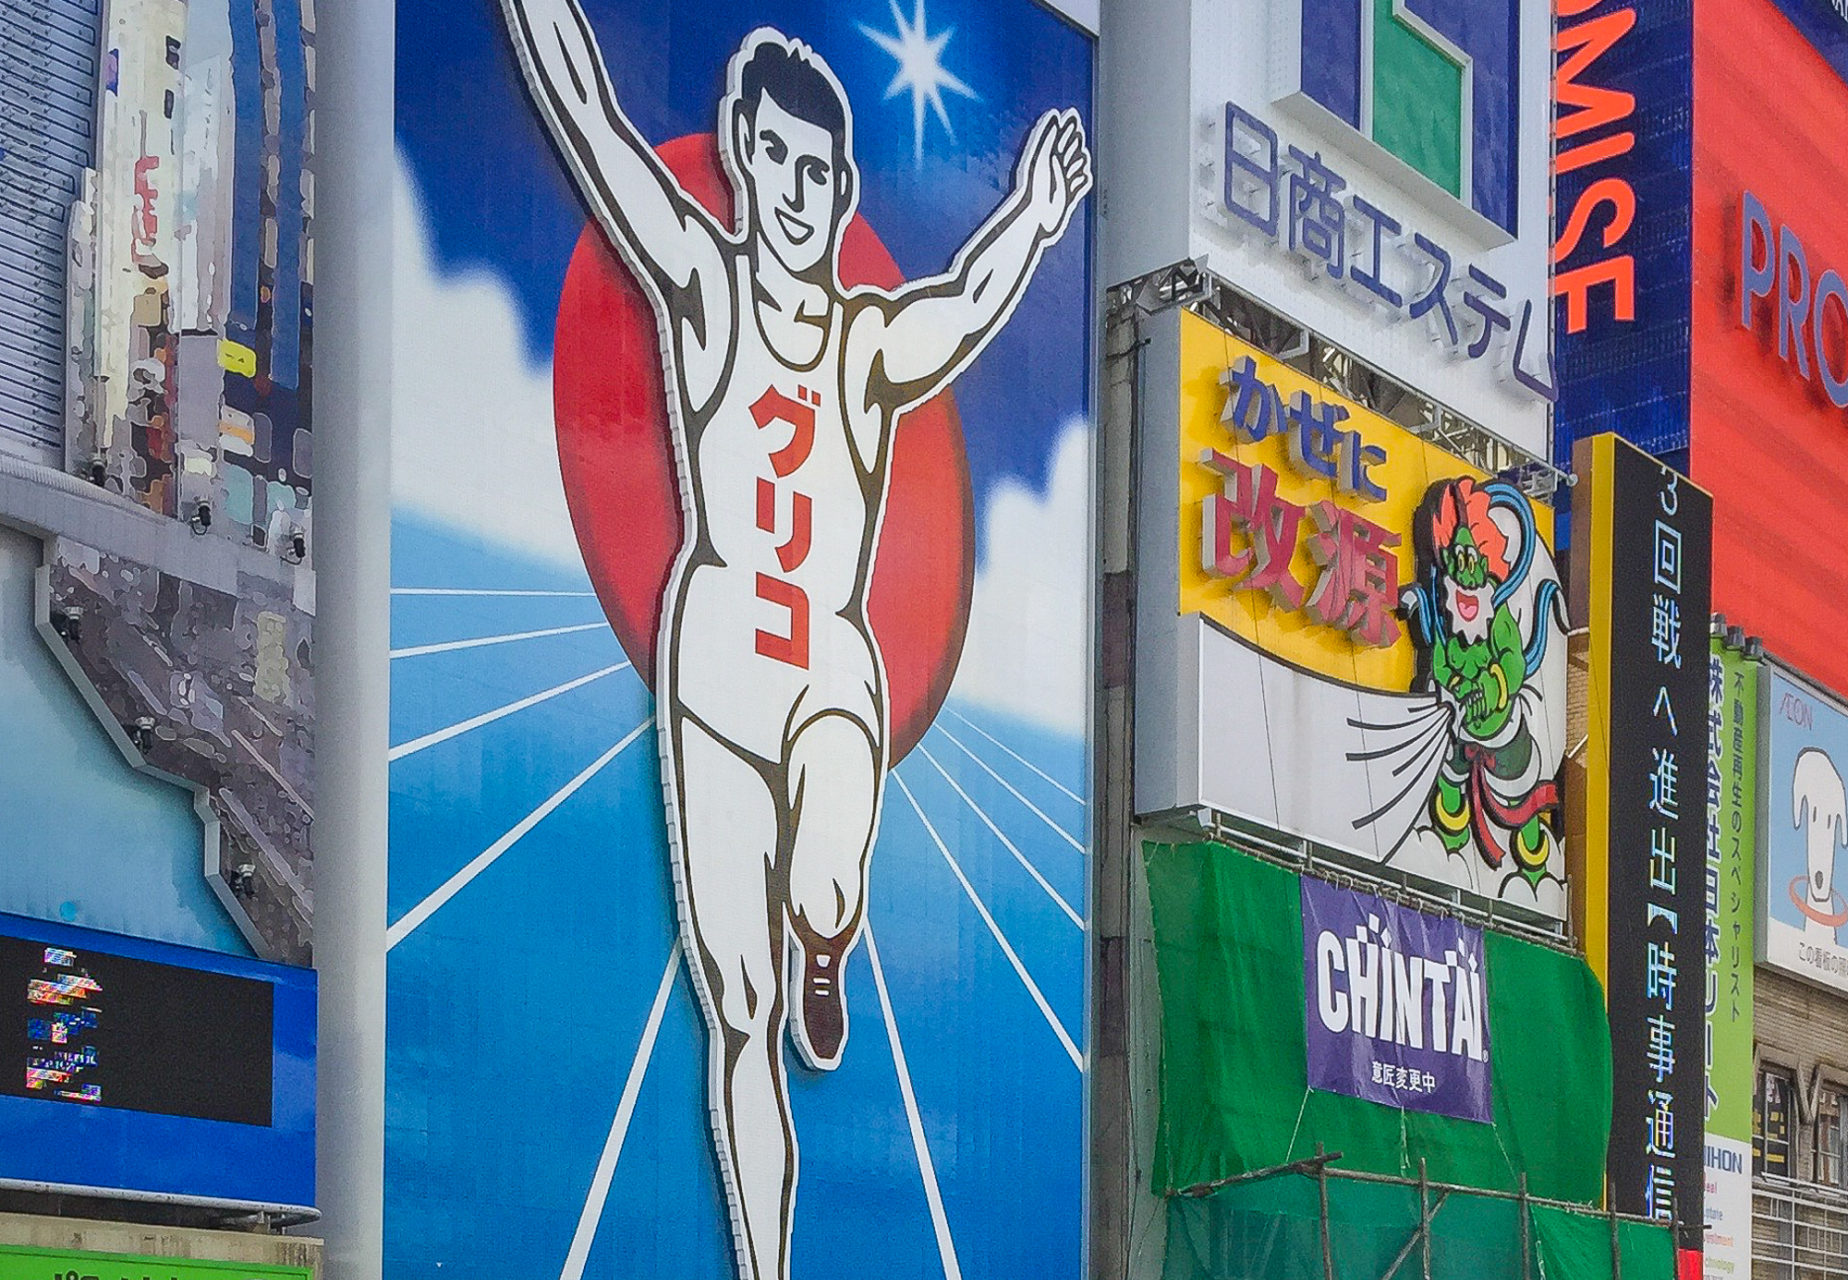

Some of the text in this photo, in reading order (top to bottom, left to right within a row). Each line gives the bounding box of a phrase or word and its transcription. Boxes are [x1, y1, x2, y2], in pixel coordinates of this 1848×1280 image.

[1551, 0, 1636, 334] MISE
[1222, 356, 1387, 501] かぜに
[749, 384, 821, 671] グリコ
[1201, 449, 1402, 646] 改源
[1371, 1060, 1436, 1094] 意匠変更中
